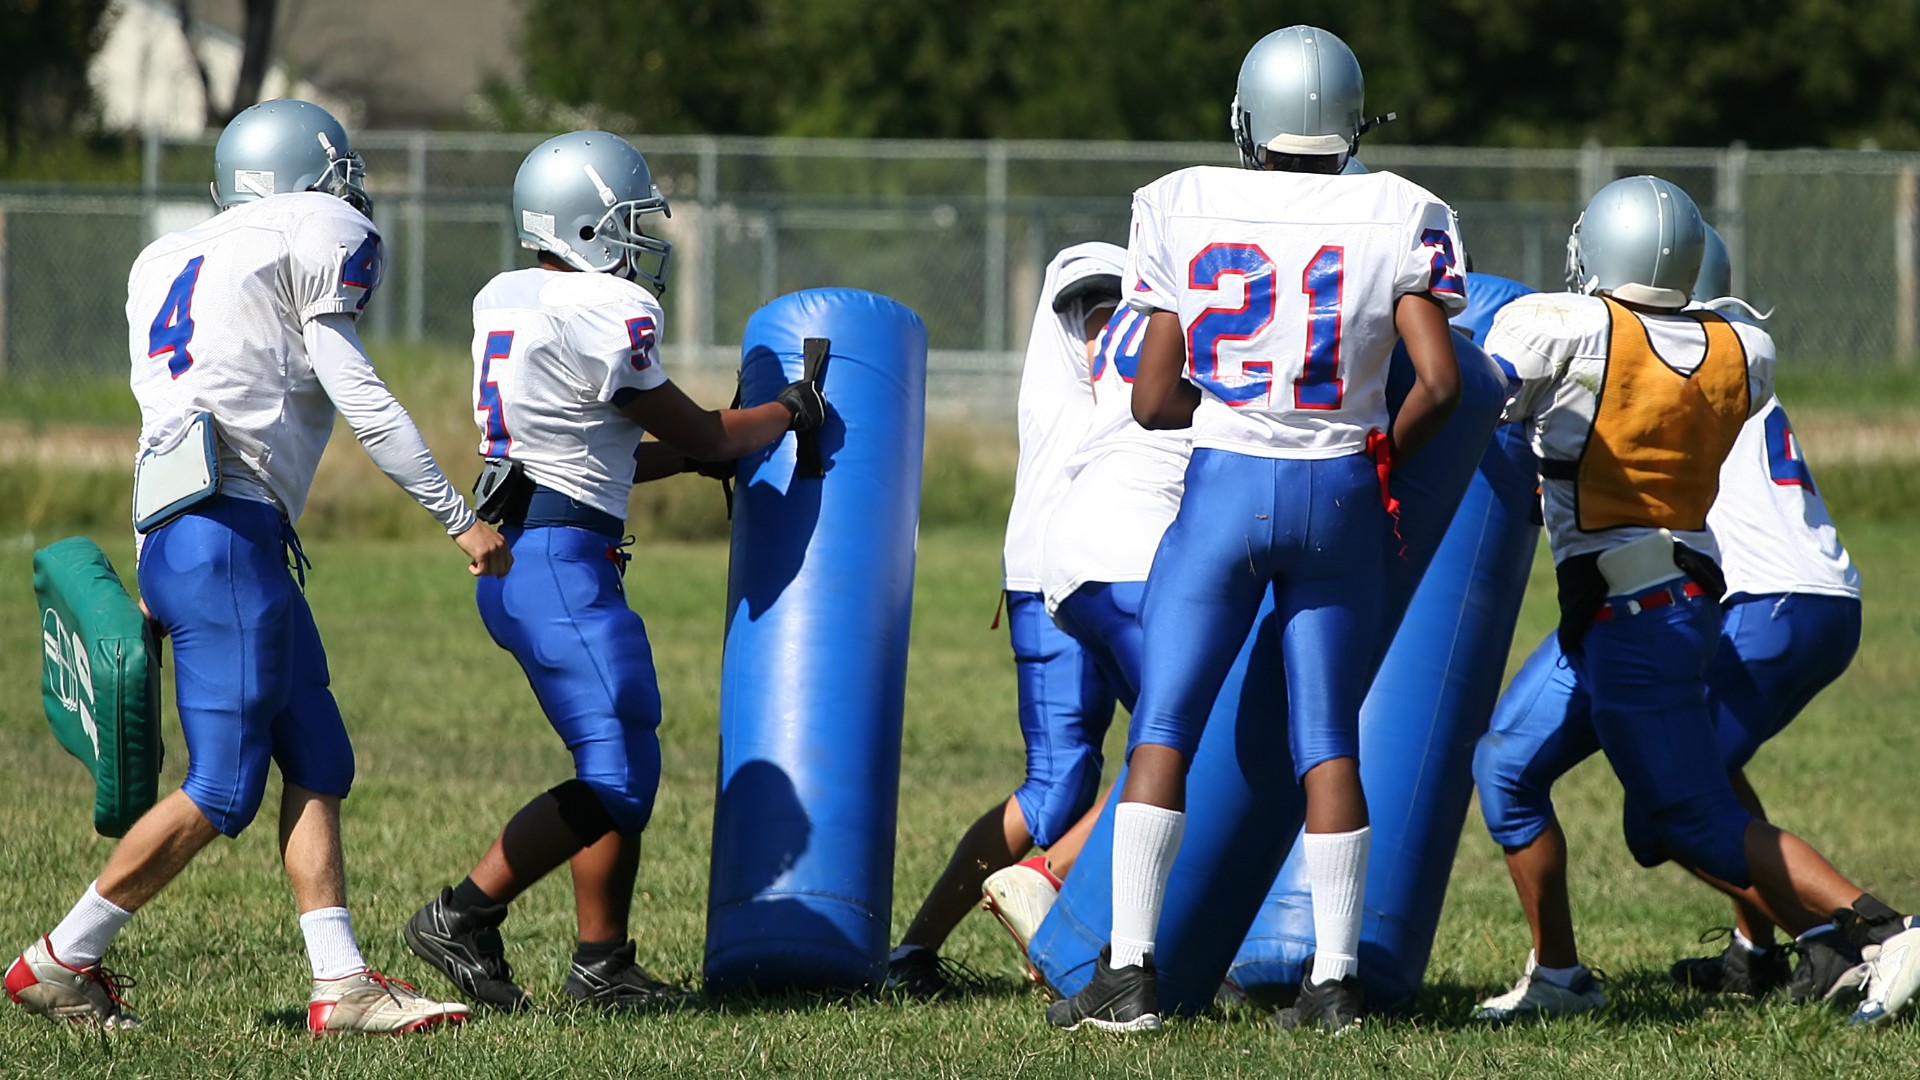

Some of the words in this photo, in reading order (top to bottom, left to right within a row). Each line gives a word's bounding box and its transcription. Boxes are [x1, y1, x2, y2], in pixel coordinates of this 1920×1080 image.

[149, 255, 204, 380] 4
[341, 231, 381, 311] 4
[1188, 243, 1344, 409] 21
[477, 330, 514, 457] 5
[625, 316, 656, 371] 5
